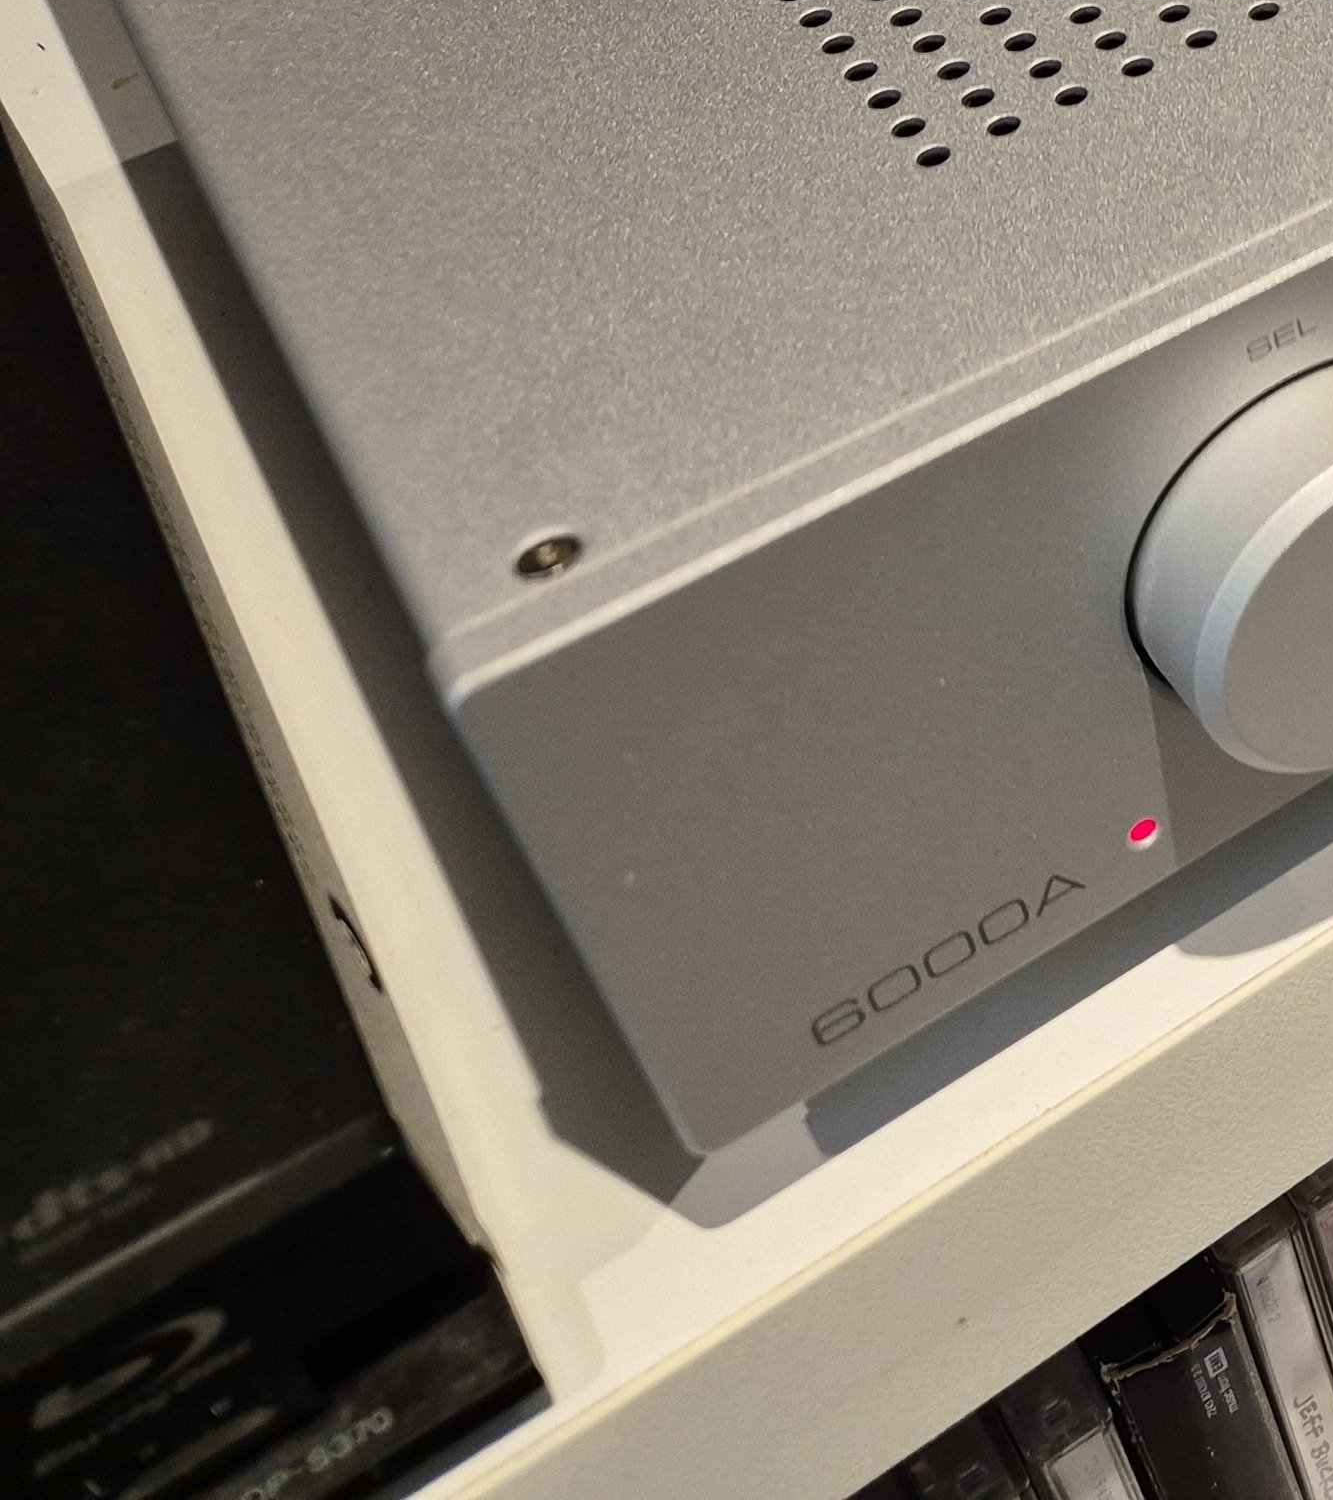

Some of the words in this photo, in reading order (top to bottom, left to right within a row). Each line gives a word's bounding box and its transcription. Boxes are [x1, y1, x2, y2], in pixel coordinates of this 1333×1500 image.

[1245, 318, 1318, 364] SEL
[809, 873, 1087, 1050] 6000A
[1293, 1394, 1324, 1440] JEFF
